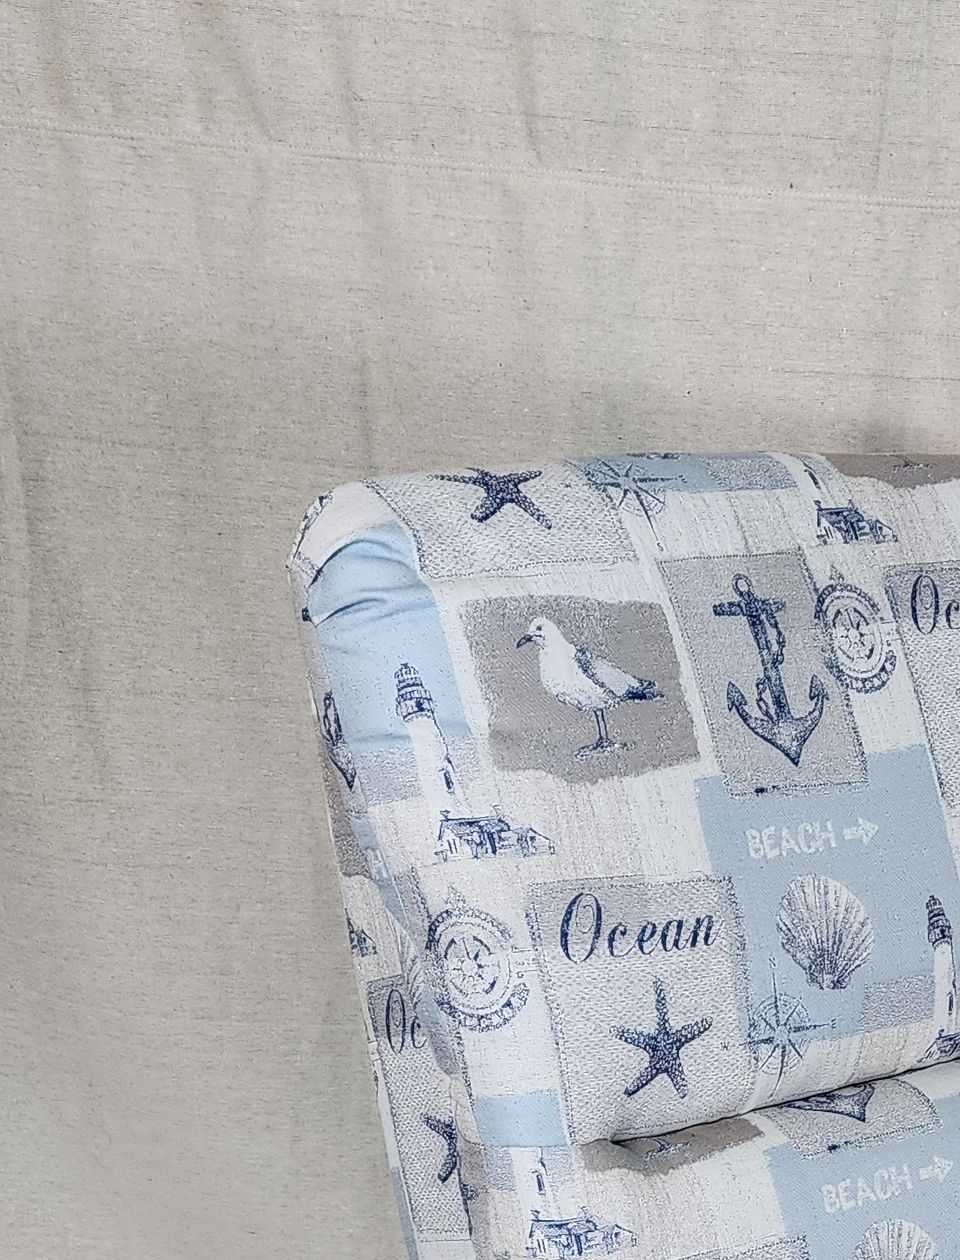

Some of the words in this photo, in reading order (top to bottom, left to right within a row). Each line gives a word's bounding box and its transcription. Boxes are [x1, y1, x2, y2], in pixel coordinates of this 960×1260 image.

[746, 820, 838, 858] BEACH
[560, 892, 726, 965] Ocean
[821, 1163, 914, 1216] BEACH
